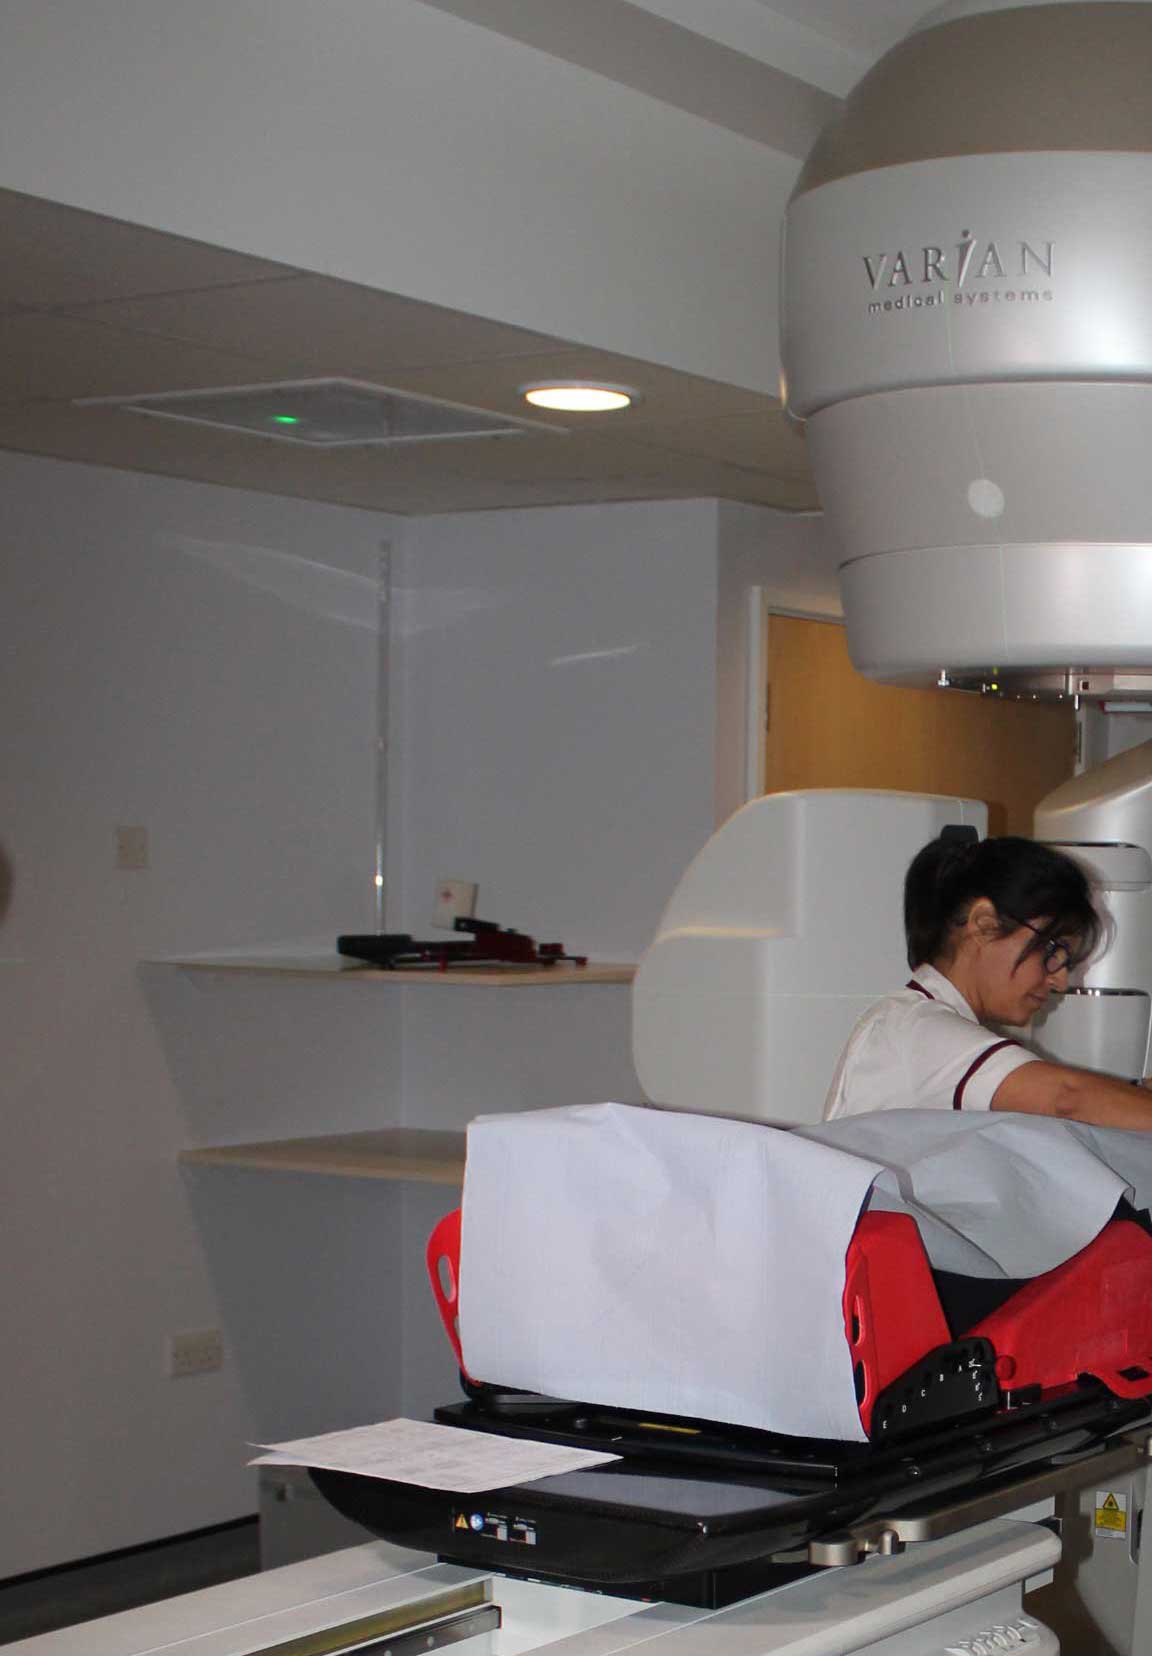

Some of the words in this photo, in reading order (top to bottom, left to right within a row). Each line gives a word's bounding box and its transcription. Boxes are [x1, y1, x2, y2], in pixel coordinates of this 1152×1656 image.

[862, 229, 1056, 289] VARIAN
[867, 290, 944, 313] medical
[953, 288, 1054, 306] systems
